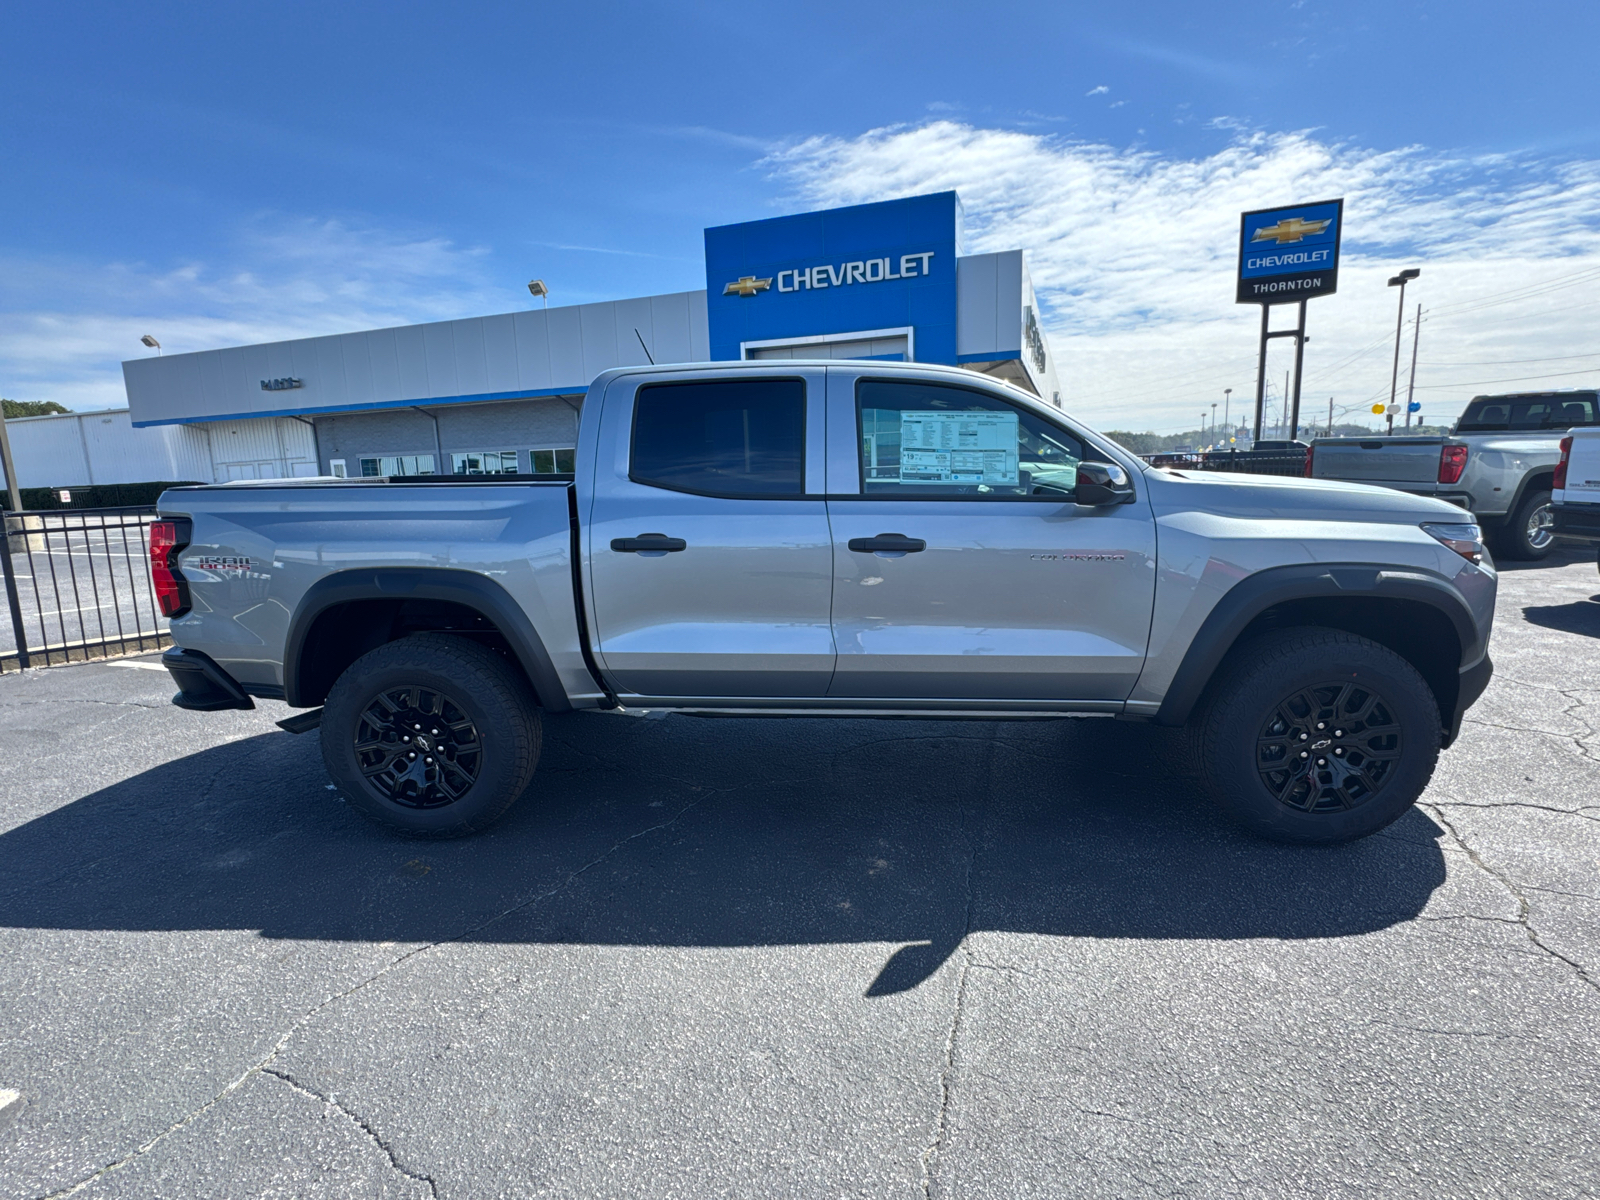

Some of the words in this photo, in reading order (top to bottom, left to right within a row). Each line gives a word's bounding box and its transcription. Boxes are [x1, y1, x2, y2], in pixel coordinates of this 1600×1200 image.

[1247, 249, 1330, 269] CHEVROLET
[777, 251, 935, 293] CHEVROLET
[1253, 278, 1322, 294] THORNTON
